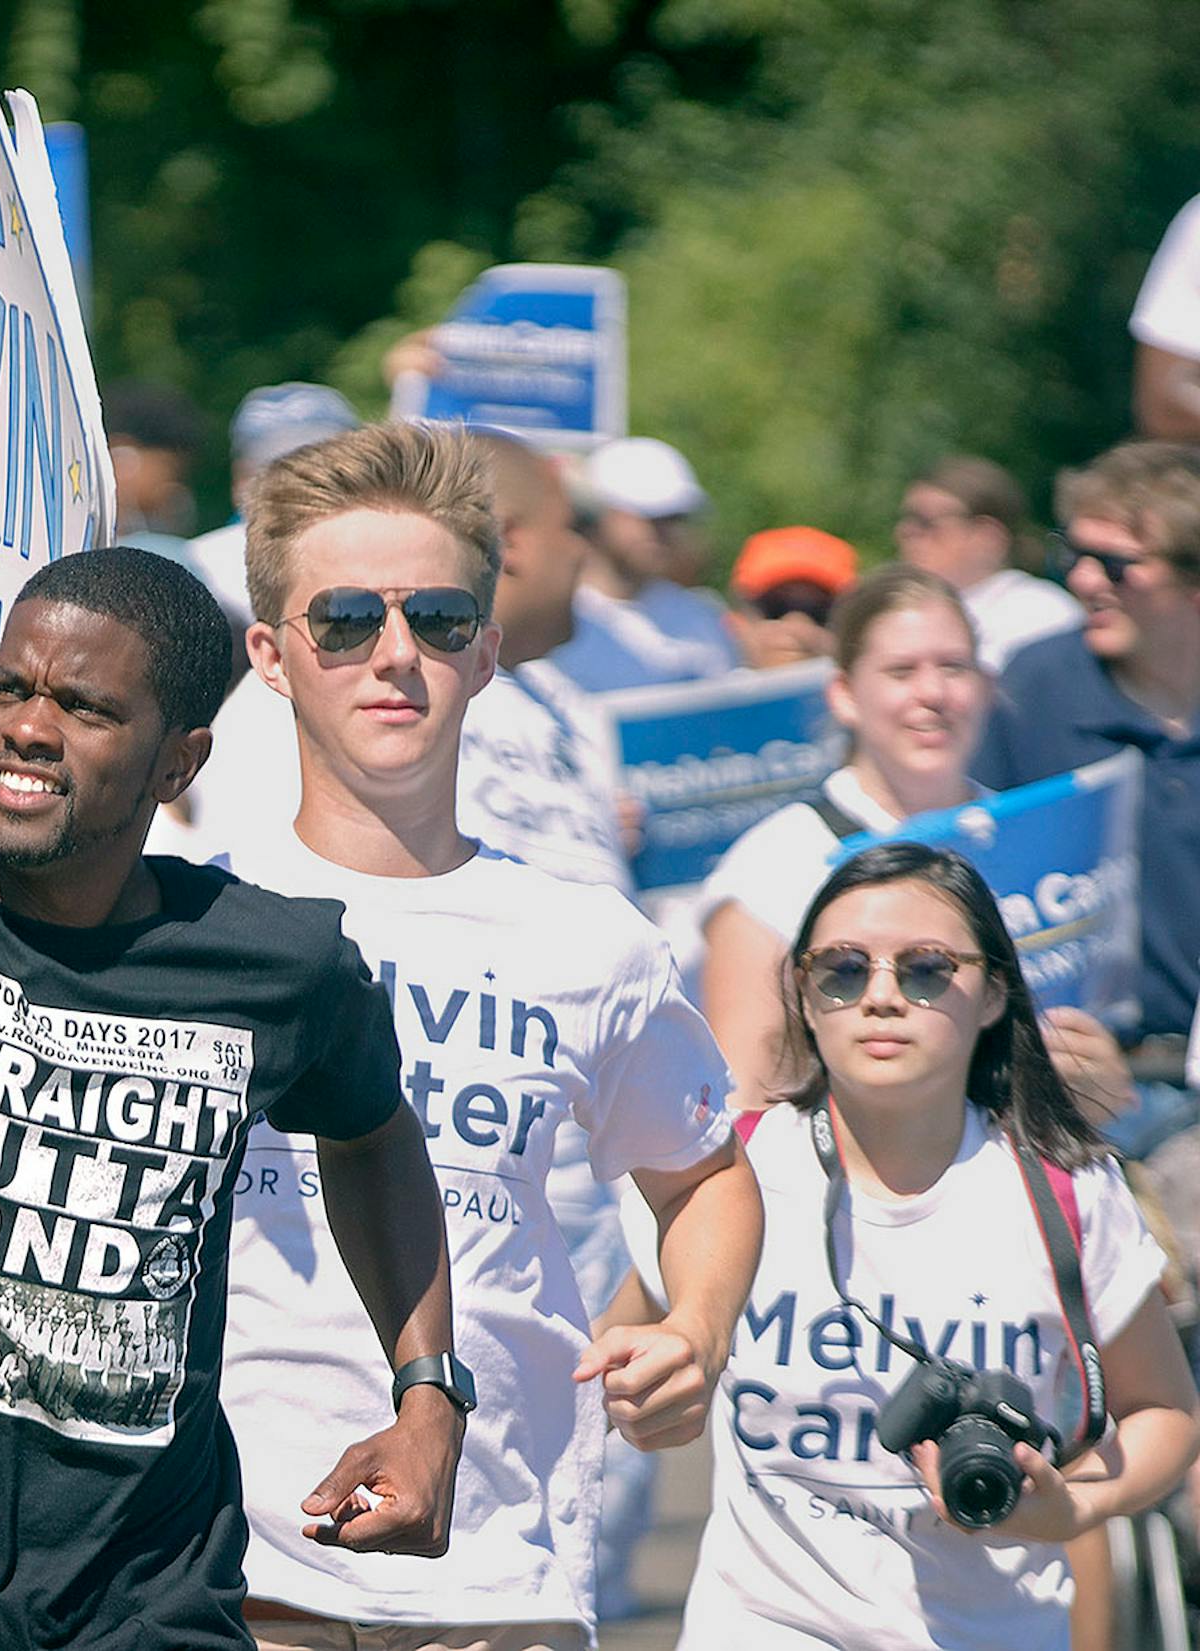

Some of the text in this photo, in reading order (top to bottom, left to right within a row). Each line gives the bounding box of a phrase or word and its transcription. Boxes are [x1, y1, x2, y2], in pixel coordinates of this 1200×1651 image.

[379, 959, 559, 1069] lvin
[64, 1019, 127, 1045] DAYS
[138, 1027, 197, 1050] 2017
[213, 1040, 245, 1056] SAT
[215, 1053, 246, 1069] JUL
[222, 1066, 239, 1081] 15
[405, 1060, 547, 1156] ter
[234, 1166, 279, 1196] OR
[730, 1290, 1042, 1376] Melvin
